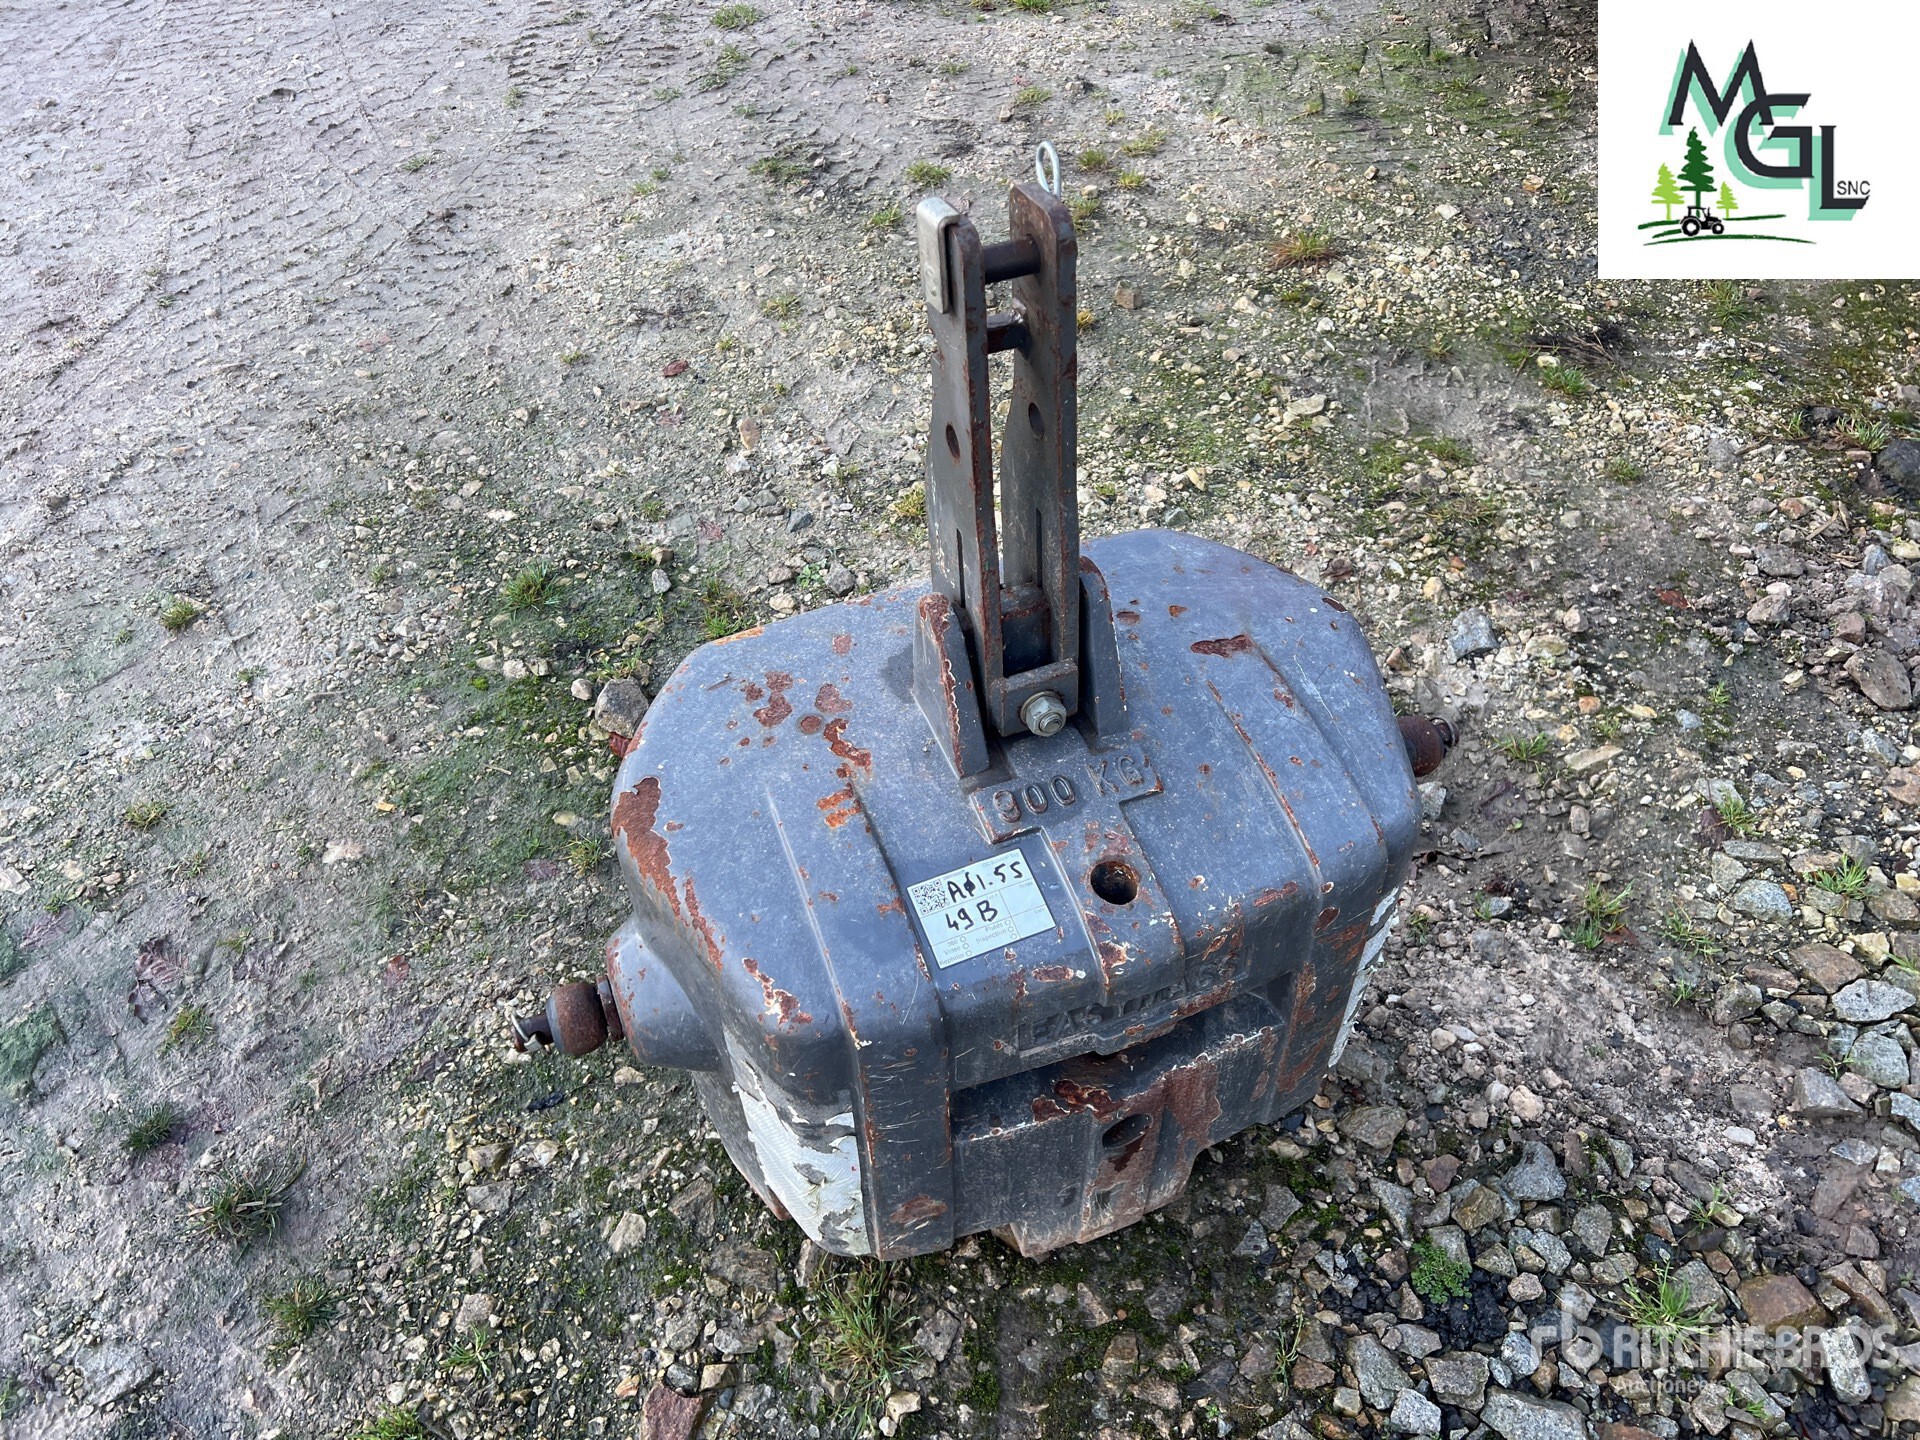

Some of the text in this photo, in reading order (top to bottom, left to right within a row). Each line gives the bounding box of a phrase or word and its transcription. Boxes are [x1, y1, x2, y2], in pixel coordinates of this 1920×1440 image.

[993, 754, 1145, 823] 900 KG
[945, 900, 998, 931] 49 B
